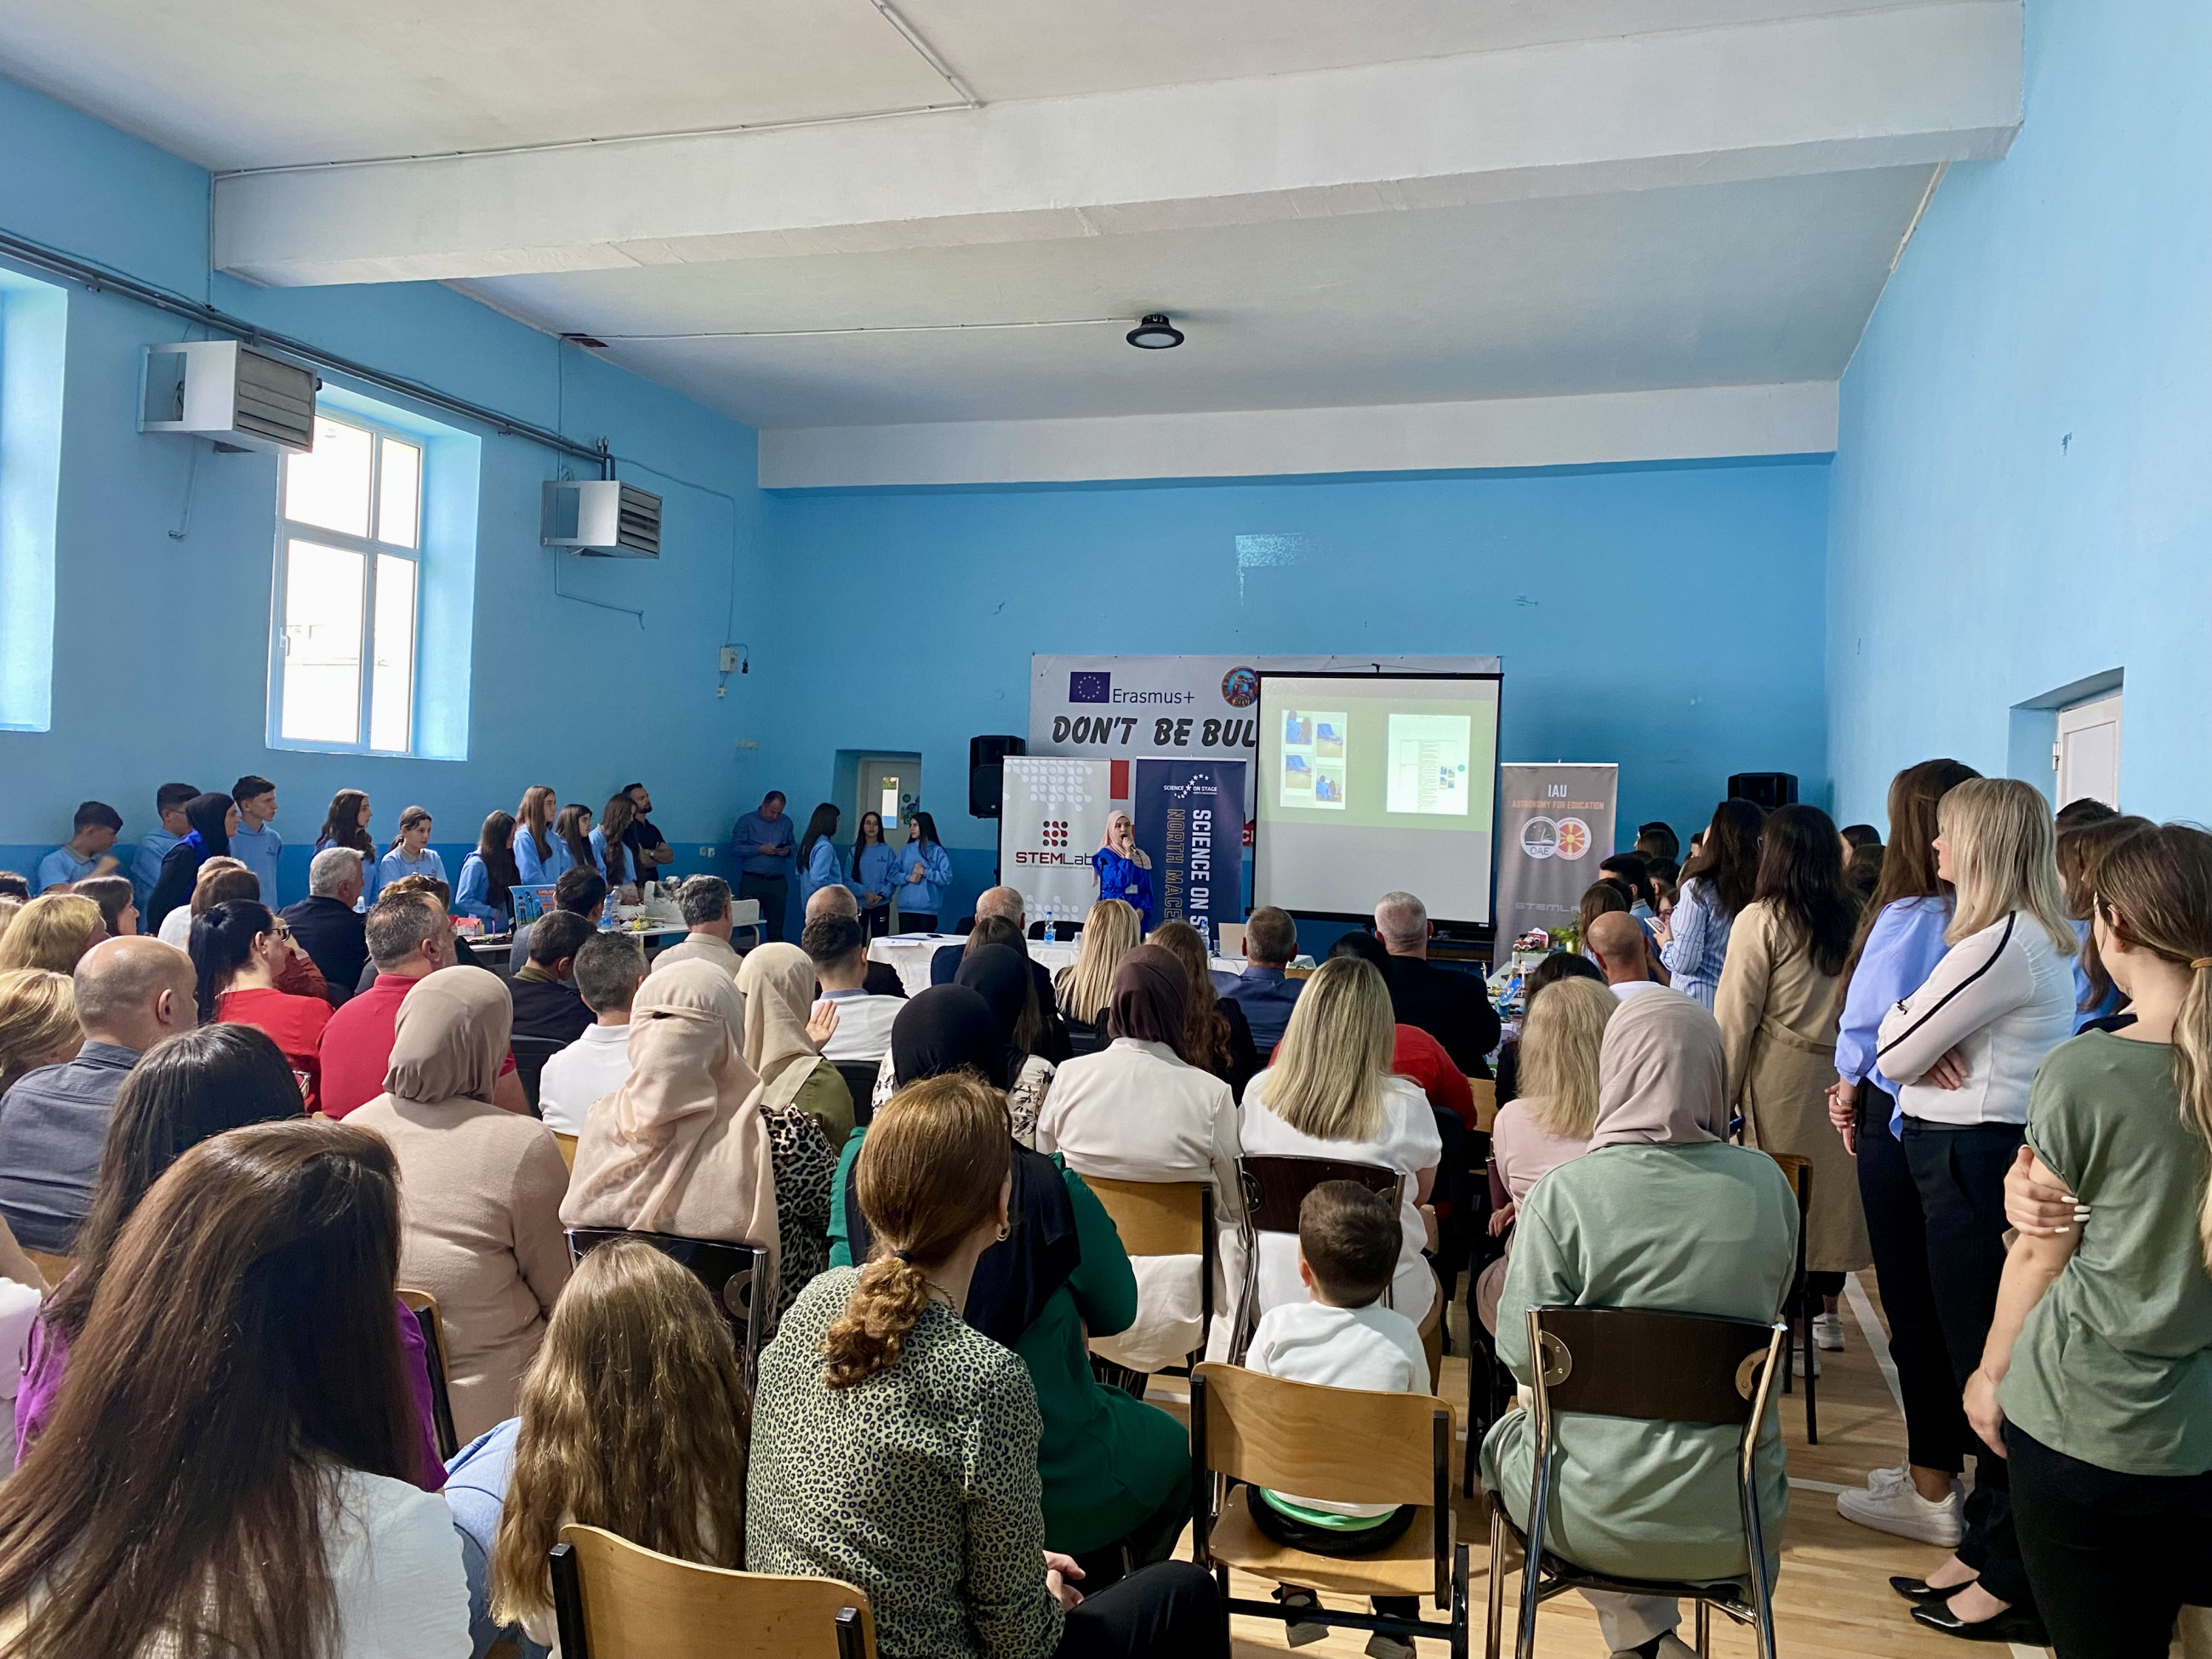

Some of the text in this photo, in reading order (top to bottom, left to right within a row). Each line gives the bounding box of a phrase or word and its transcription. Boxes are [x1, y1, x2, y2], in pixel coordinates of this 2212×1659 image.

[1113, 688, 1194, 704] Erasmus+
[1052, 716, 1137, 744] DON'T
[1154, 718, 1193, 746] BE
[1548, 784, 1567, 797] IAU
[1513, 800, 1605, 810] ASTRONOMY FOR EDUCATION
[1166, 808, 1185, 864] NORTH
[1192, 809, 1211, 881] SCIENCE
[1530, 847, 1550, 856] OAE
[1016, 852, 1092, 865] STEMLab
[1190, 887, 1210, 909] ON
[1190, 915, 1209, 931] S
